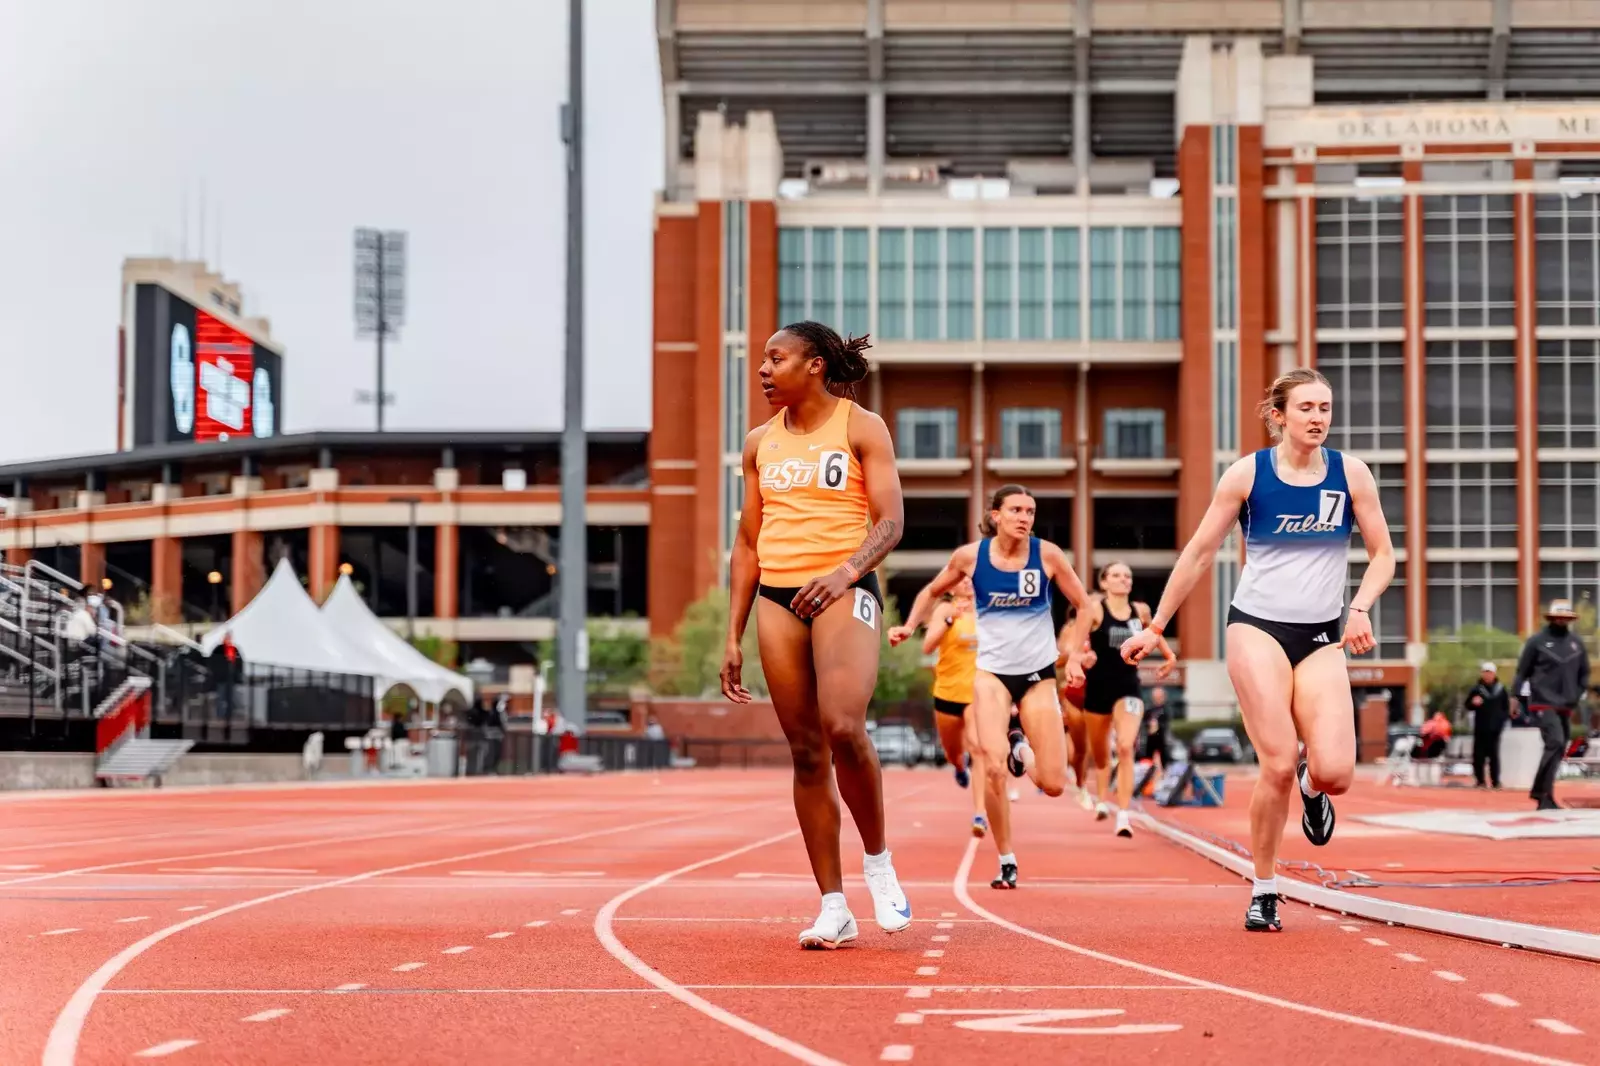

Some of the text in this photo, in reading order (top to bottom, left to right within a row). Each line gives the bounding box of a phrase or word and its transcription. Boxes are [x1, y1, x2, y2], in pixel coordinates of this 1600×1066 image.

[1338, 117, 1511, 137] OKLAHOMA
[761, 458, 819, 492] OSU
[825, 452, 843, 488] 6
[1326, 492, 1341, 523] 7
[1024, 571, 1036, 595] 8
[859, 594, 872, 622] 6
[988, 592, 1032, 608] Tulsa
